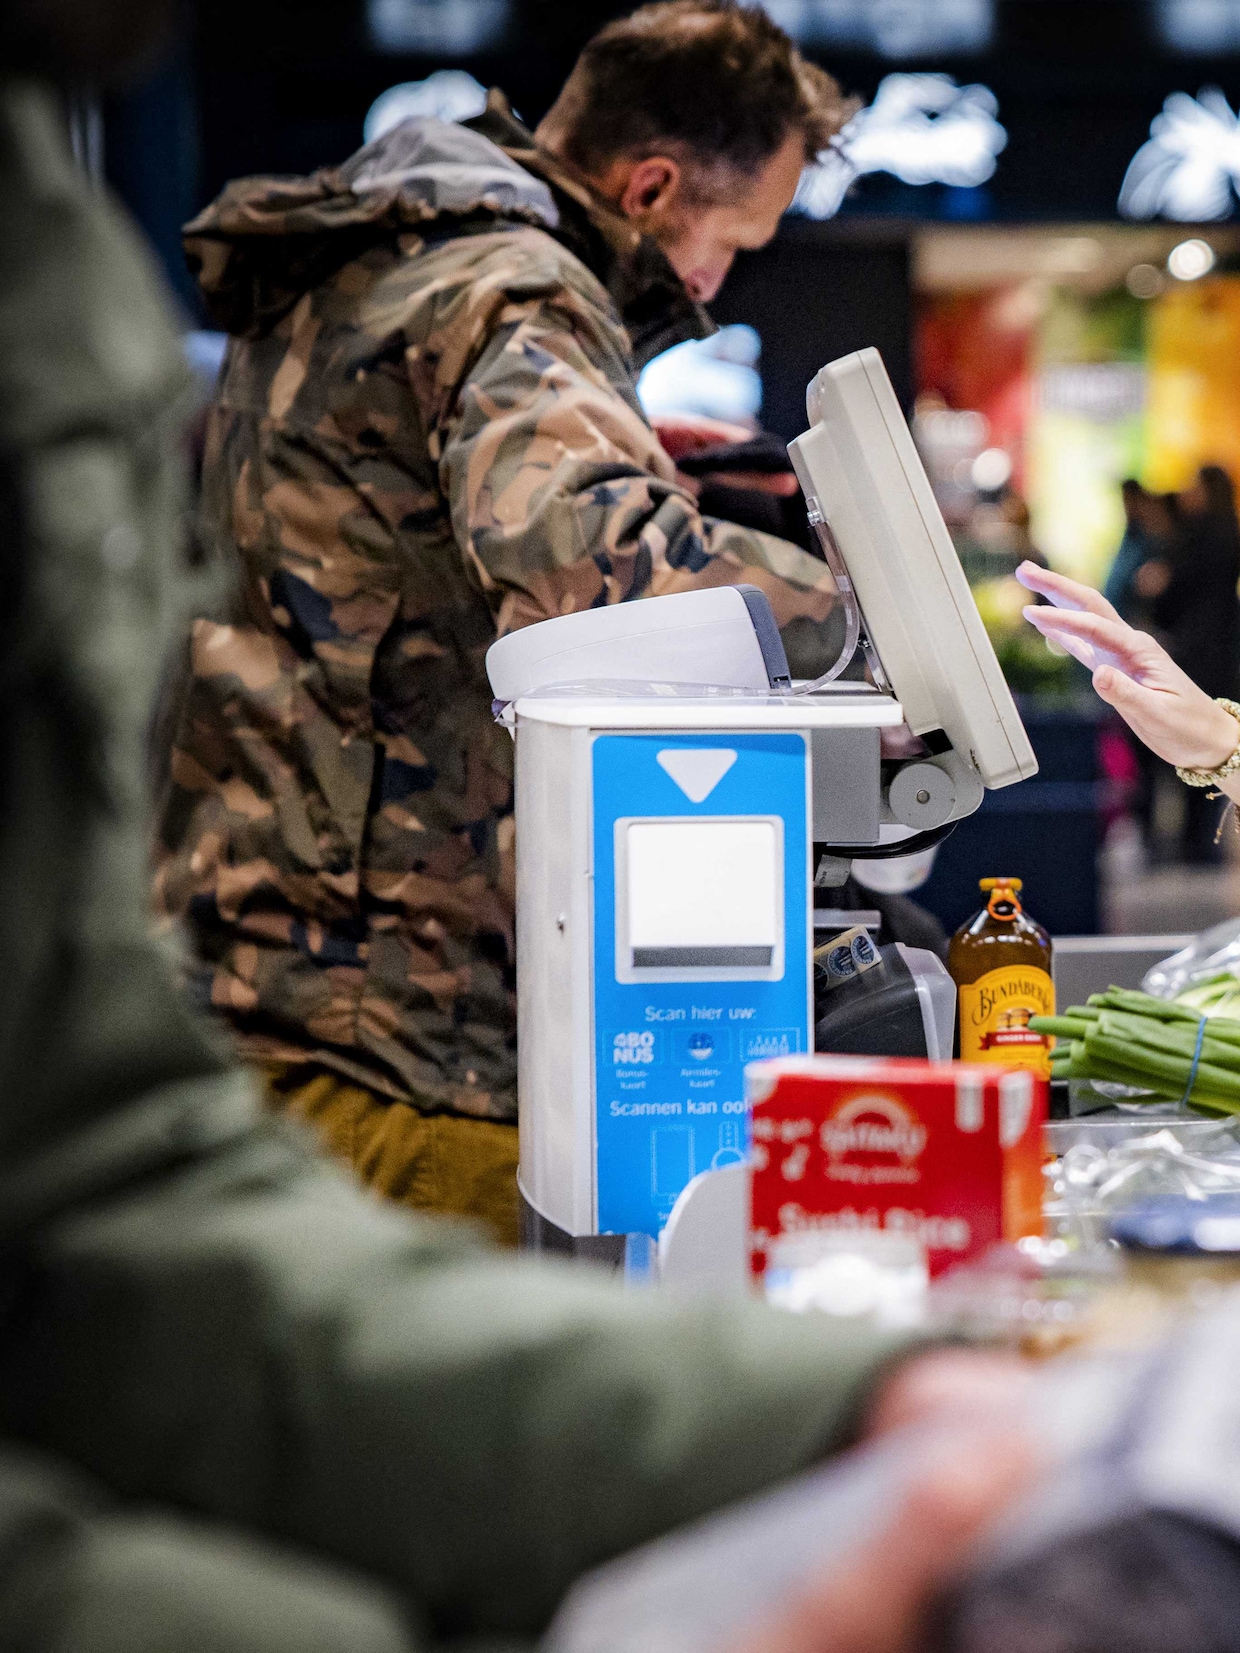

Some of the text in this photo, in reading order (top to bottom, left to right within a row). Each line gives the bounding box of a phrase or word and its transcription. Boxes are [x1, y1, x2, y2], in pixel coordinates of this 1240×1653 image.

[644, 1004, 686, 1022] Scan
[691, 1005, 723, 1021] hier
[609, 1100, 682, 1117] Scannen
[687, 1099, 718, 1115] kan
